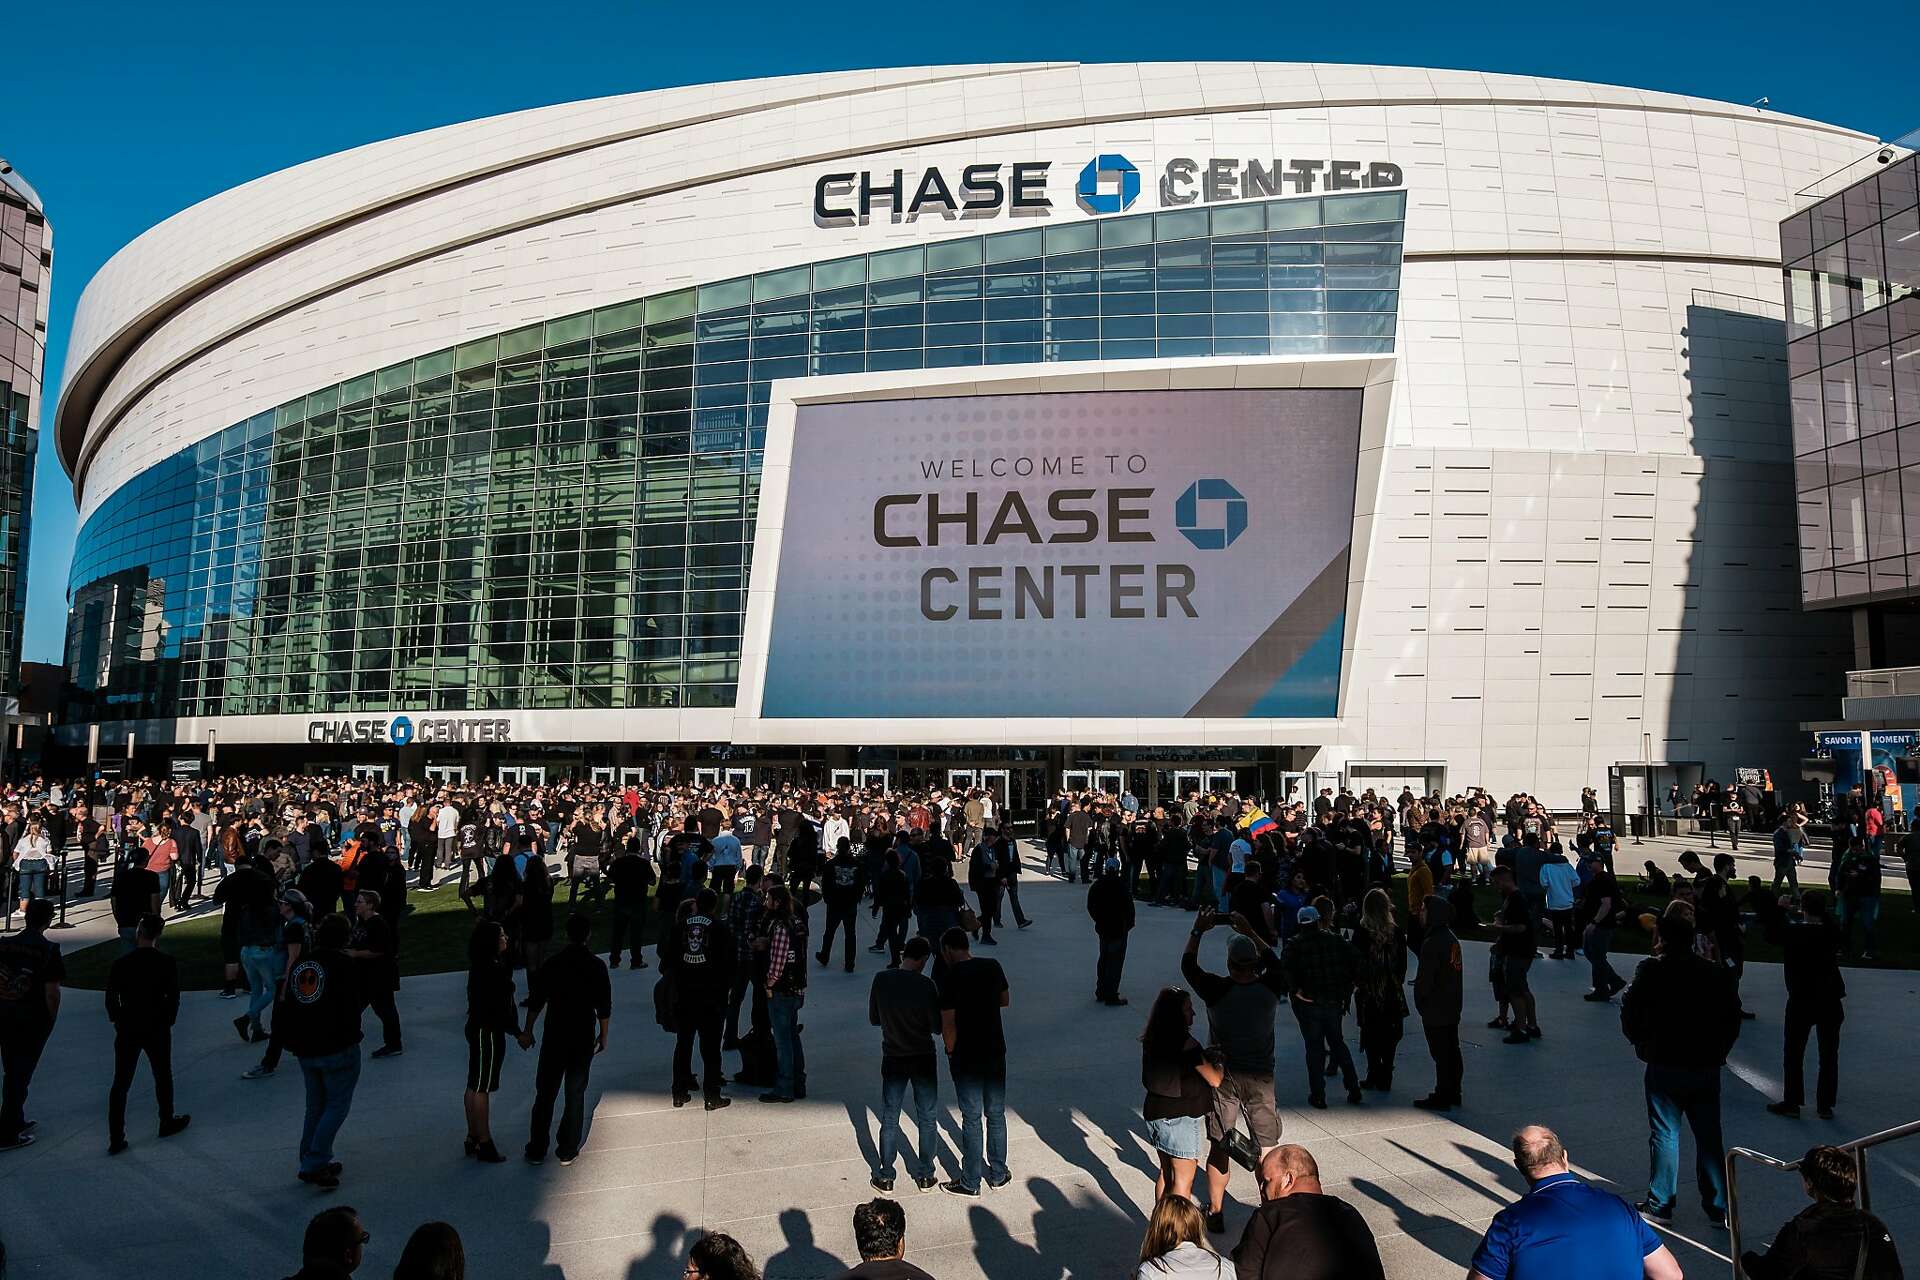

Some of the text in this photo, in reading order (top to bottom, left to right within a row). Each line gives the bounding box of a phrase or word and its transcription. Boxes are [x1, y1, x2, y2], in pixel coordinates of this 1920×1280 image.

[814, 161, 1053, 220] CHASE
[920, 454, 1147, 479] WELCOME TO
[873, 487, 1156, 547] CHASE
[920, 563, 1199, 621] CENTER
[308, 719, 511, 743] CHASE CENTER
[1824, 736, 1852, 744] SAVOR
[1871, 735, 1910, 744] MOMENT
